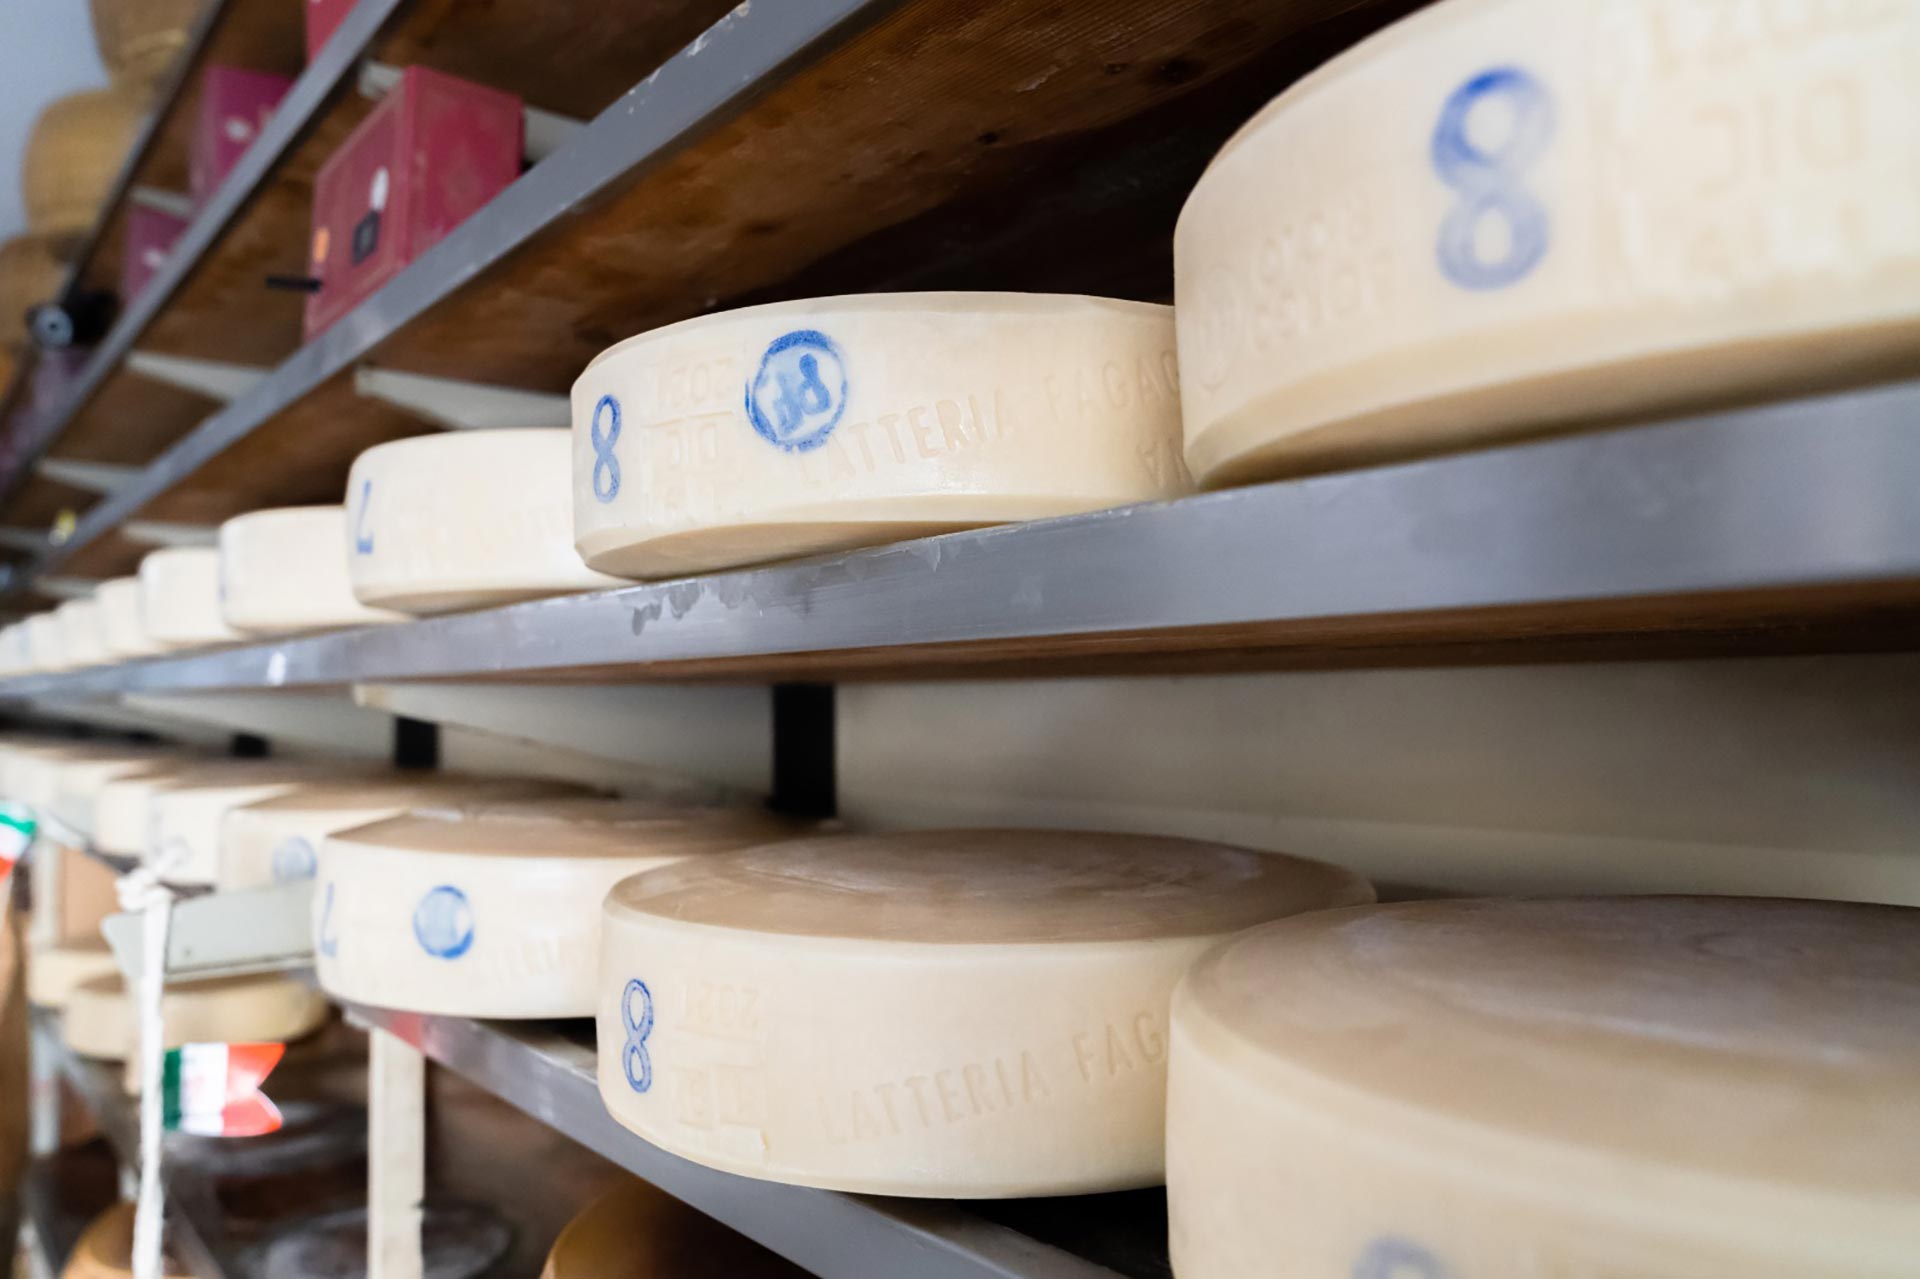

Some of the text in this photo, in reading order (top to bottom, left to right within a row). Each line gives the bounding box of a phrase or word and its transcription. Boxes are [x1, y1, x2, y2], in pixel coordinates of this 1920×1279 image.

[1428, 61, 1560, 291] 8
[592, 394, 622, 505] 8
[798, 387, 1015, 488] LATTERIA
[621, 977, 655, 1095] 8
[814, 1048, 1053, 1147] LATTERIA
